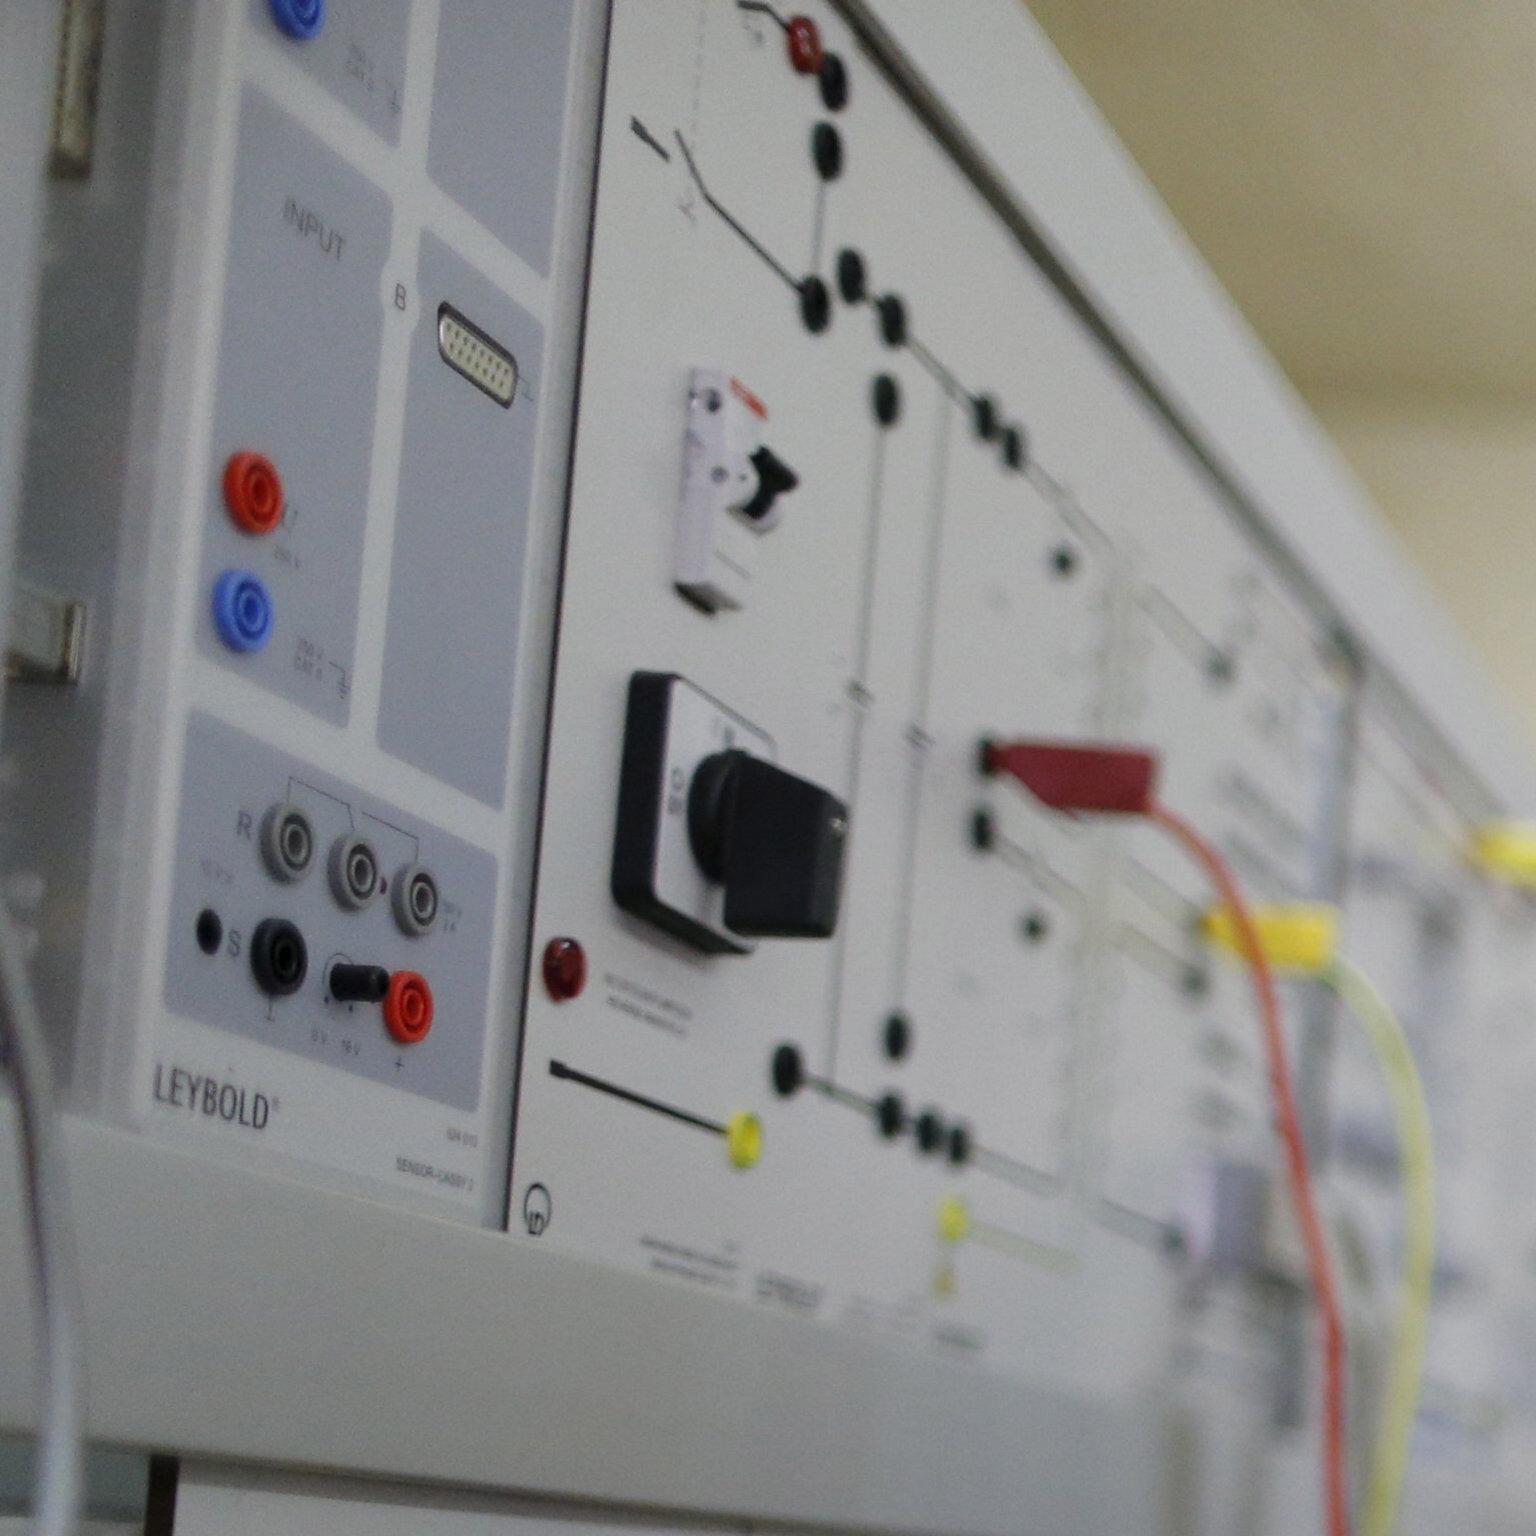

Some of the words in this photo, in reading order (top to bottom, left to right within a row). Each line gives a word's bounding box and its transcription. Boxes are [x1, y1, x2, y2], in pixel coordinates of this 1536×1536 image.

[283, 196, 347, 262] INPUT
[394, 282, 407, 312] B
[236, 809, 253, 841] R
[226, 929, 243, 958] S
